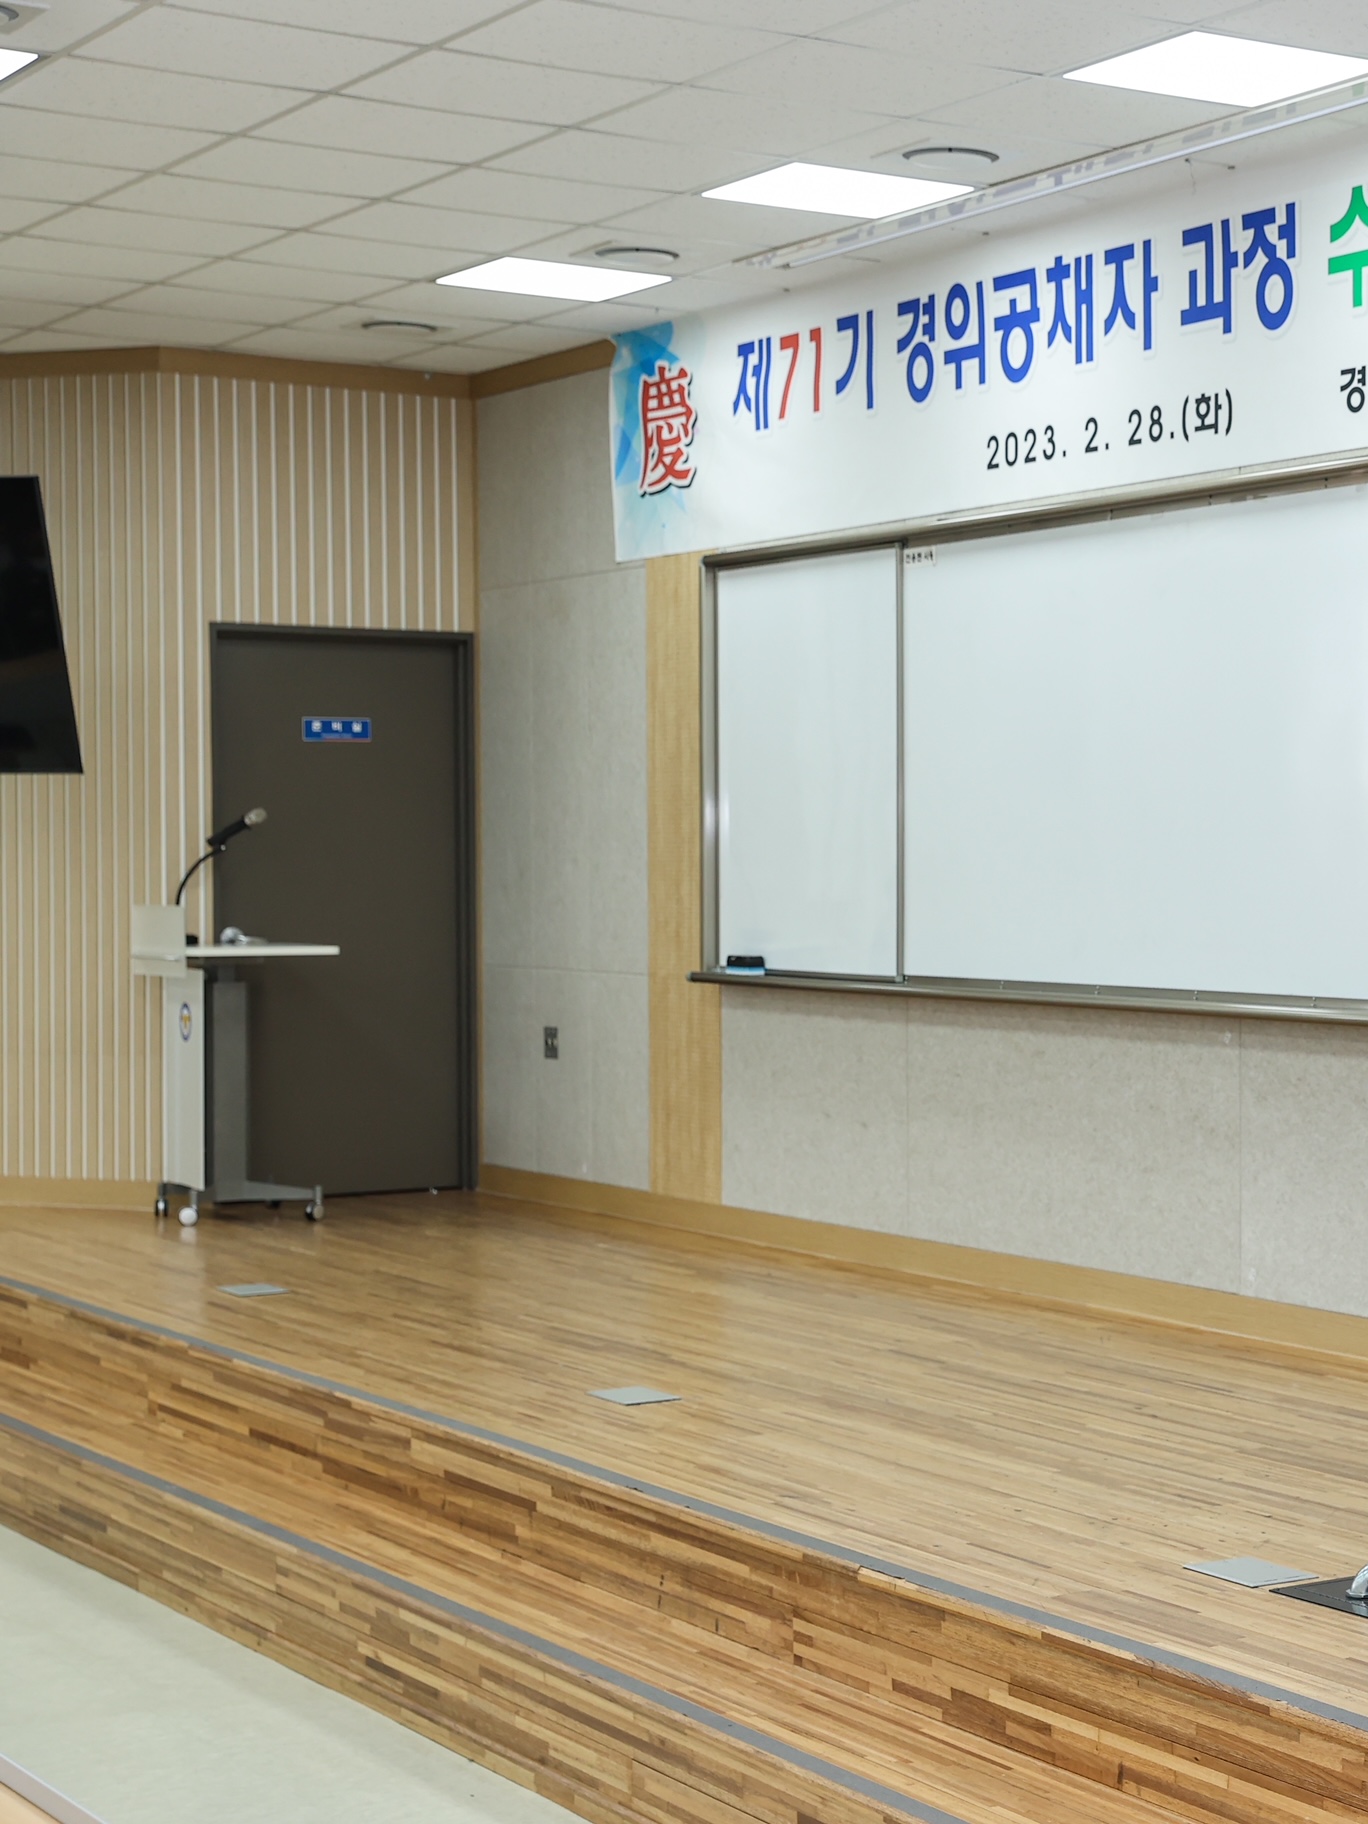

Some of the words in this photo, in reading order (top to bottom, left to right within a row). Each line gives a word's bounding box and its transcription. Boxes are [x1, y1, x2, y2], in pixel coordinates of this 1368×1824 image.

[733, 311, 874, 431] 제71기
[897, 240, 1159, 402] 경위공채자
[1180, 202, 1296, 334] 과정
[640, 366, 693, 489] 慶
[987, 425, 1066, 470] 2023.
[1084, 417, 1109, 453] 2.
[1128, 388, 1233, 446] 28.(화)
